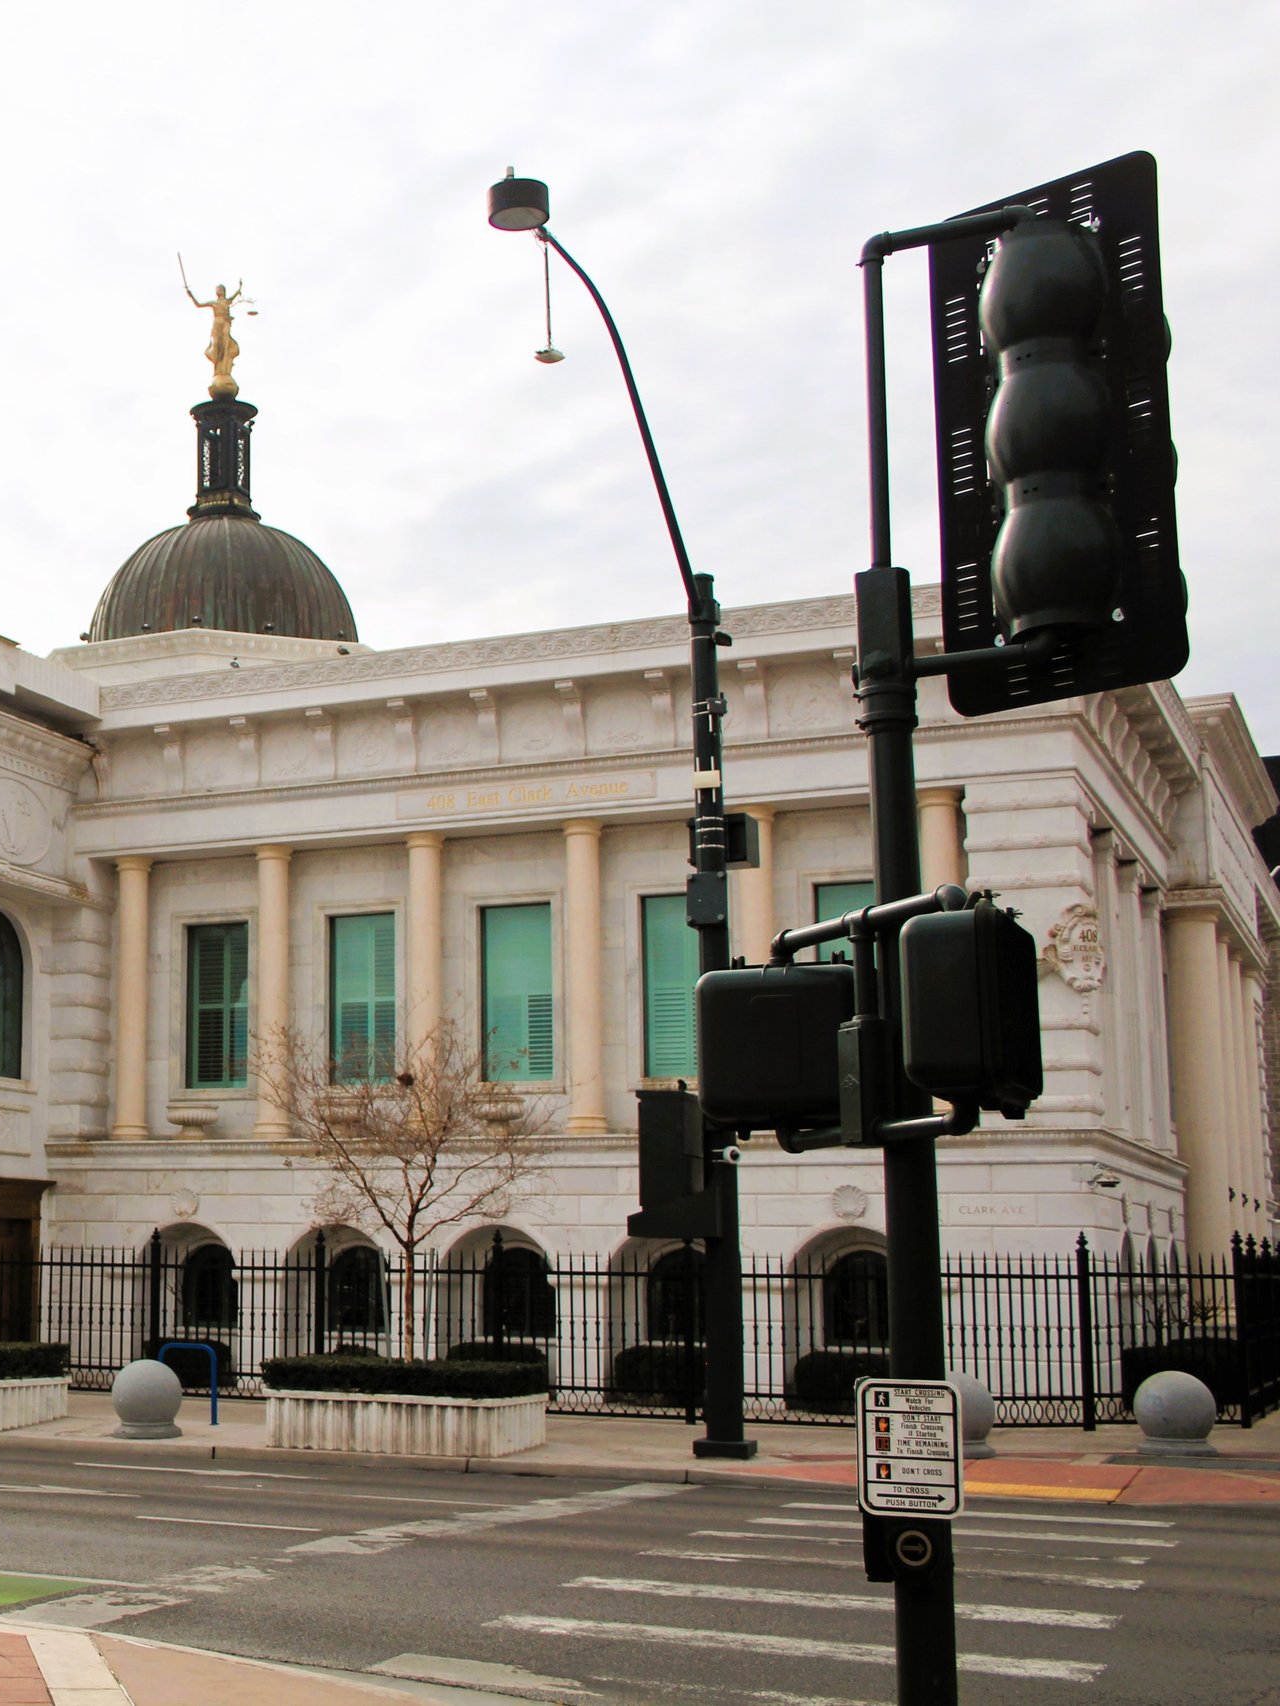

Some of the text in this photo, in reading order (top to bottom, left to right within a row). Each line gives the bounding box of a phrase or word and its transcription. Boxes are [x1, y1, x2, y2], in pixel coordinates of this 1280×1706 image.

[426, 779, 629, 811] 408 East Clark Avenue
[1079, 928, 1097, 943] 408
[958, 1205, 1025, 1215] CLARK AVE
[894, 1388, 945, 1397] START CROSSING
[921, 1424, 943, 1432] Crossing
[915, 1440, 949, 1448] REMAINING
[926, 1449, 950, 1457] Crossing
[923, 1468, 943, 1476] CROSS
[905, 1486, 929, 1494] CROSS
[909, 1499, 937, 1508] BUTTON
